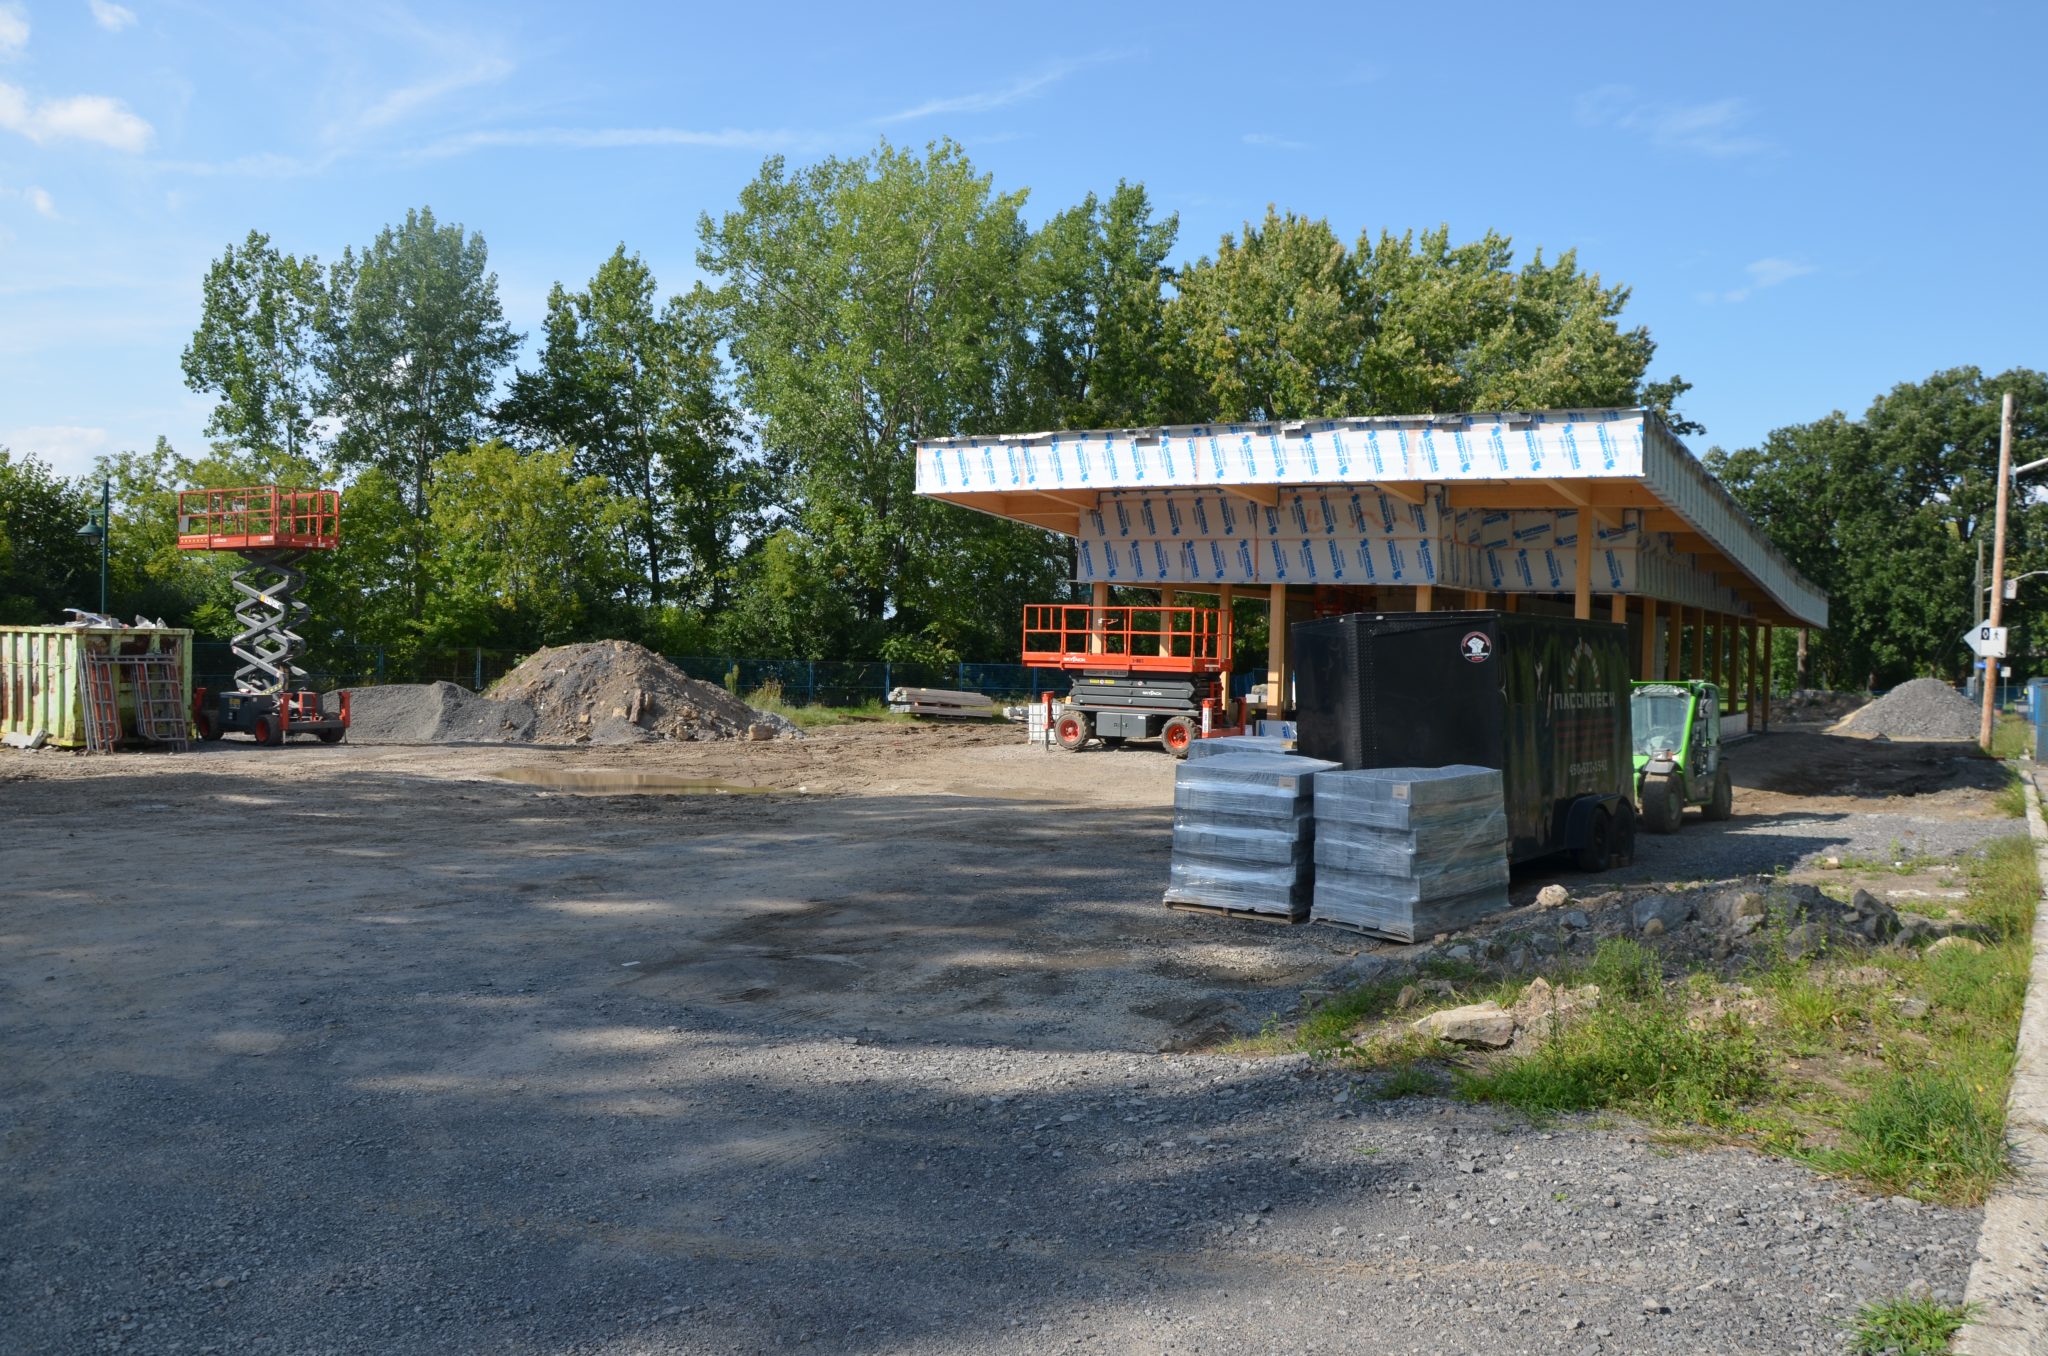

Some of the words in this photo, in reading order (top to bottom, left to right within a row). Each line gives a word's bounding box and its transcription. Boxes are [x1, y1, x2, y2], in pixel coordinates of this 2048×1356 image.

[1428, 438, 1439, 472] SOPREMA
[1454, 429, 1465, 463] SOPREMA
[1496, 436, 1508, 470] SOPREMA
[1524, 427, 1536, 461] SOPREMA
[1569, 434, 1580, 469] SOPREMA
[1597, 424, 1608, 460] SOPREMA
[1554, 692, 1616, 710] MACONTECH
